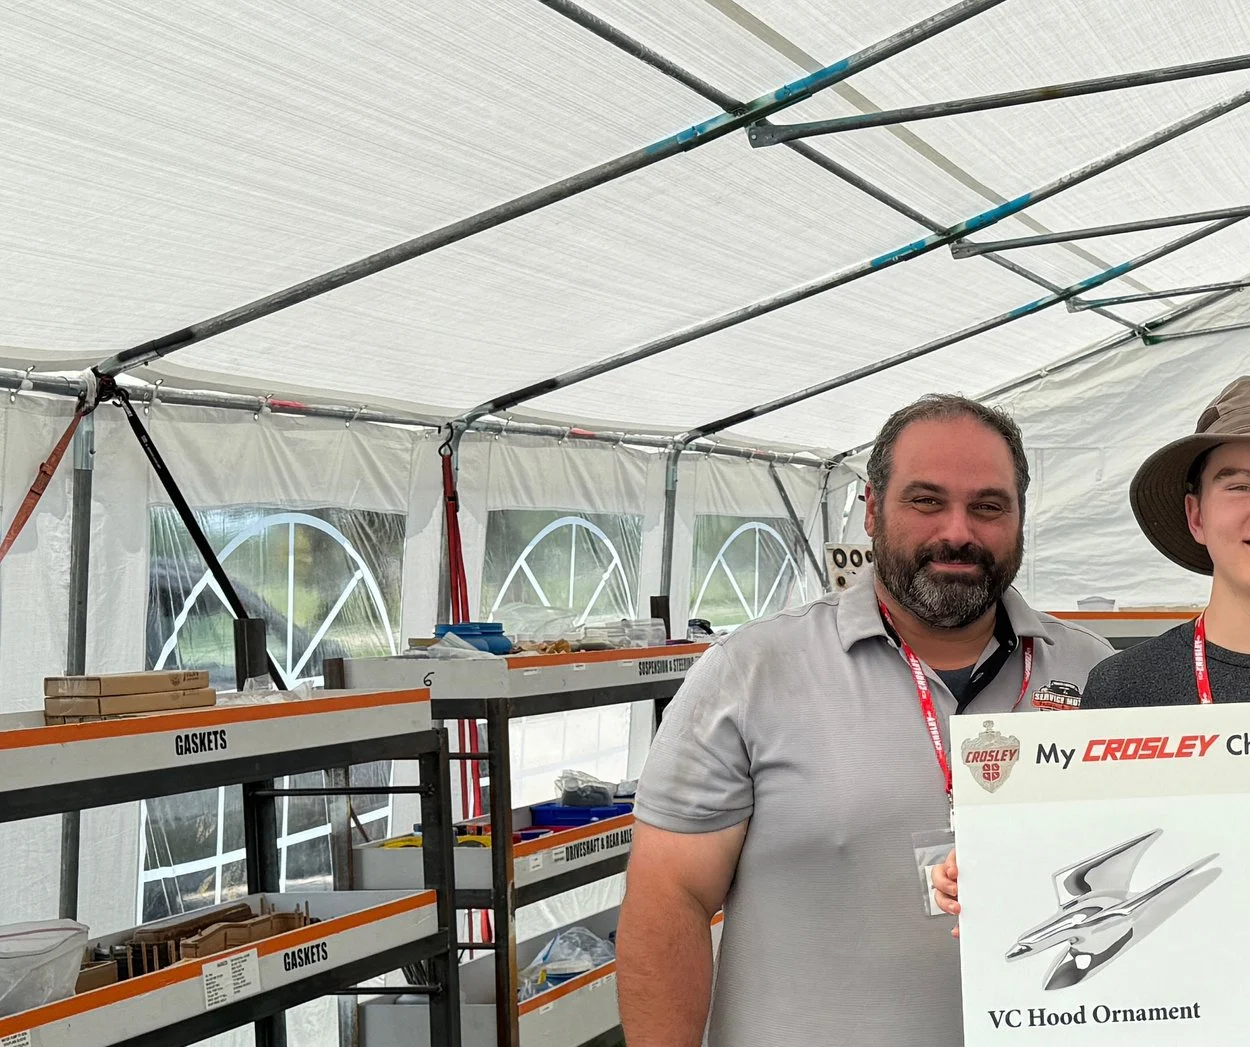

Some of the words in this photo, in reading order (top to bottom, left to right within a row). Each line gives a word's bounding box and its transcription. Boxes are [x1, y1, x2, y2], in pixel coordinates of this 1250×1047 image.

[175, 729, 227, 756] GASKETS
[1036, 743, 1076, 770] My
[1082, 734, 1221, 762] CROSLEY
[965, 749, 1019, 765] CROSLEY
[565, 837, 600, 861] DRIVESHAFT
[605, 832, 620, 850] REAR
[283, 942, 328, 971] GASKETS
[988, 1009, 1022, 1029] VC
[1028, 1005, 1087, 1027] Hood
[1092, 1002, 1201, 1023] Ornament
